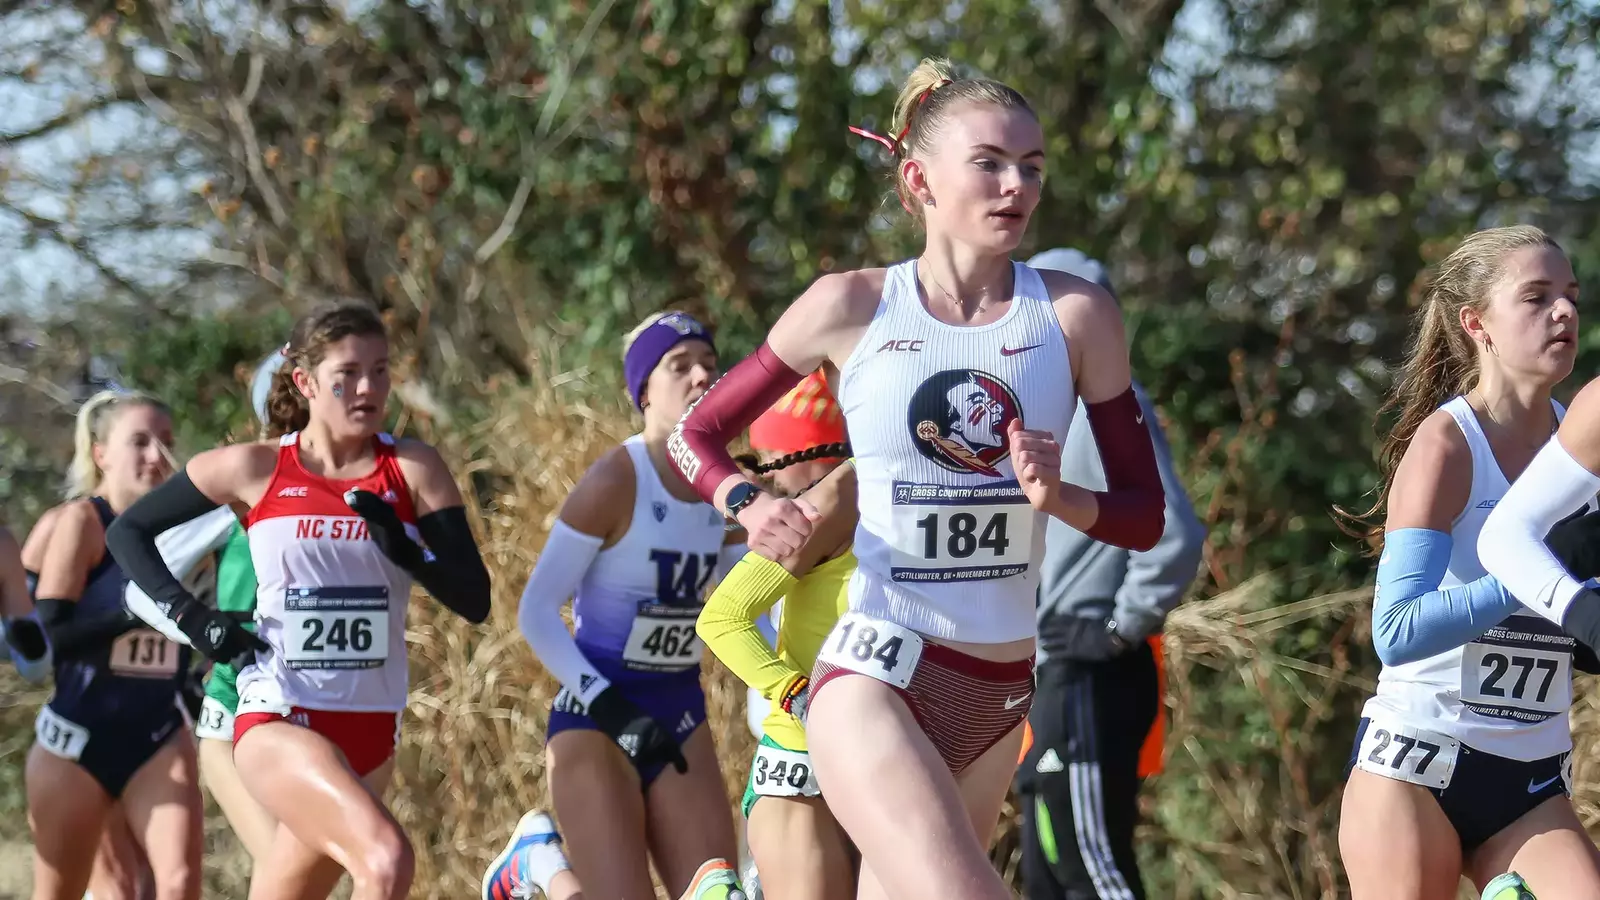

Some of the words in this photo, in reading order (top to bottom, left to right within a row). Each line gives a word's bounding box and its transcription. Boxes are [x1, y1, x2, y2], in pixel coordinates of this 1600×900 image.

[876, 339, 925, 353] ACC
[277, 486, 309, 498] ACC
[911, 488, 937, 497] CROSS
[938, 488, 973, 498] COUNTRY
[973, 486, 1025, 498] CHAMPIONSHI
[296, 519, 325, 540] NC
[330, 519, 369, 541] STA
[916, 512, 1009, 559] 184
[649, 548, 718, 604] W
[900, 571, 942, 580] STILLWATER,
[943, 571, 952, 580] OK
[955, 570, 991, 580] NOVEMBER
[128, 635, 167, 666] 131
[302, 618, 372, 652] 246
[642, 624, 696, 658] 462
[835, 621, 904, 672] 184
[1506, 631, 1534, 642] COUNTRY
[1480, 653, 1558, 703] 277
[41, 718, 73, 752] 131
[1367, 728, 1441, 775] 277
[756, 756, 809, 789] 340
